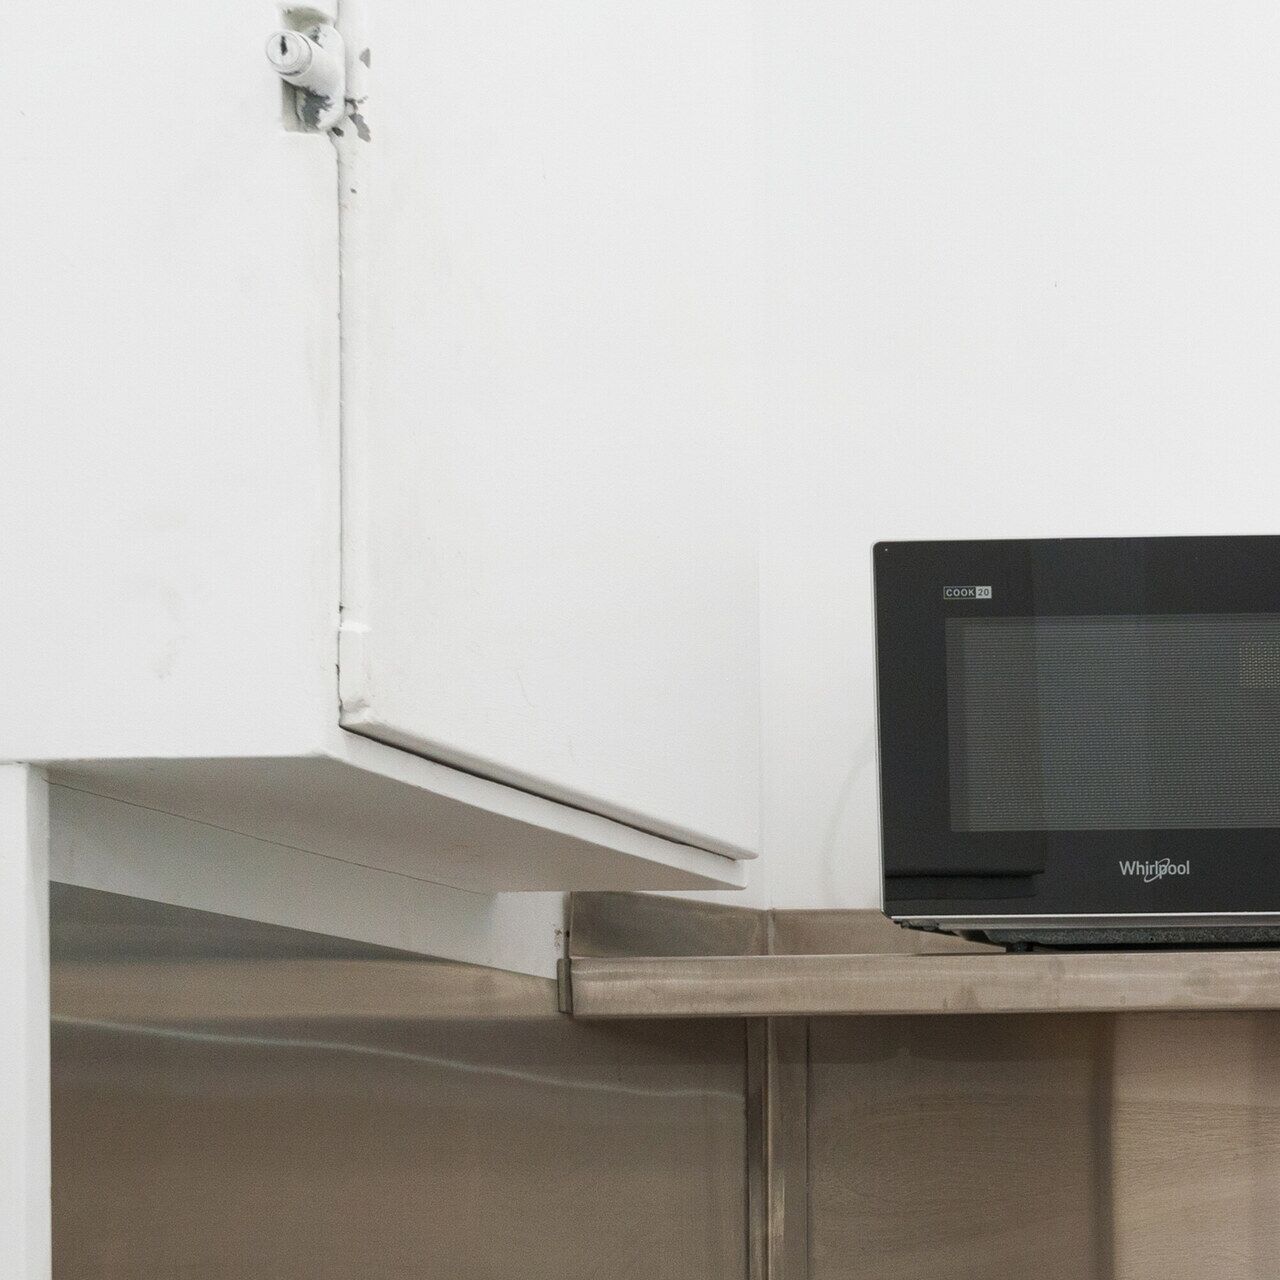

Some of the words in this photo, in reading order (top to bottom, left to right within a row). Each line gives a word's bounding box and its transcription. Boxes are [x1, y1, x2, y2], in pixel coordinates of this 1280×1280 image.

[946, 588, 975, 597] COOK
[978, 588, 990, 596] 20
[1118, 859, 1190, 881] Whirlpool
